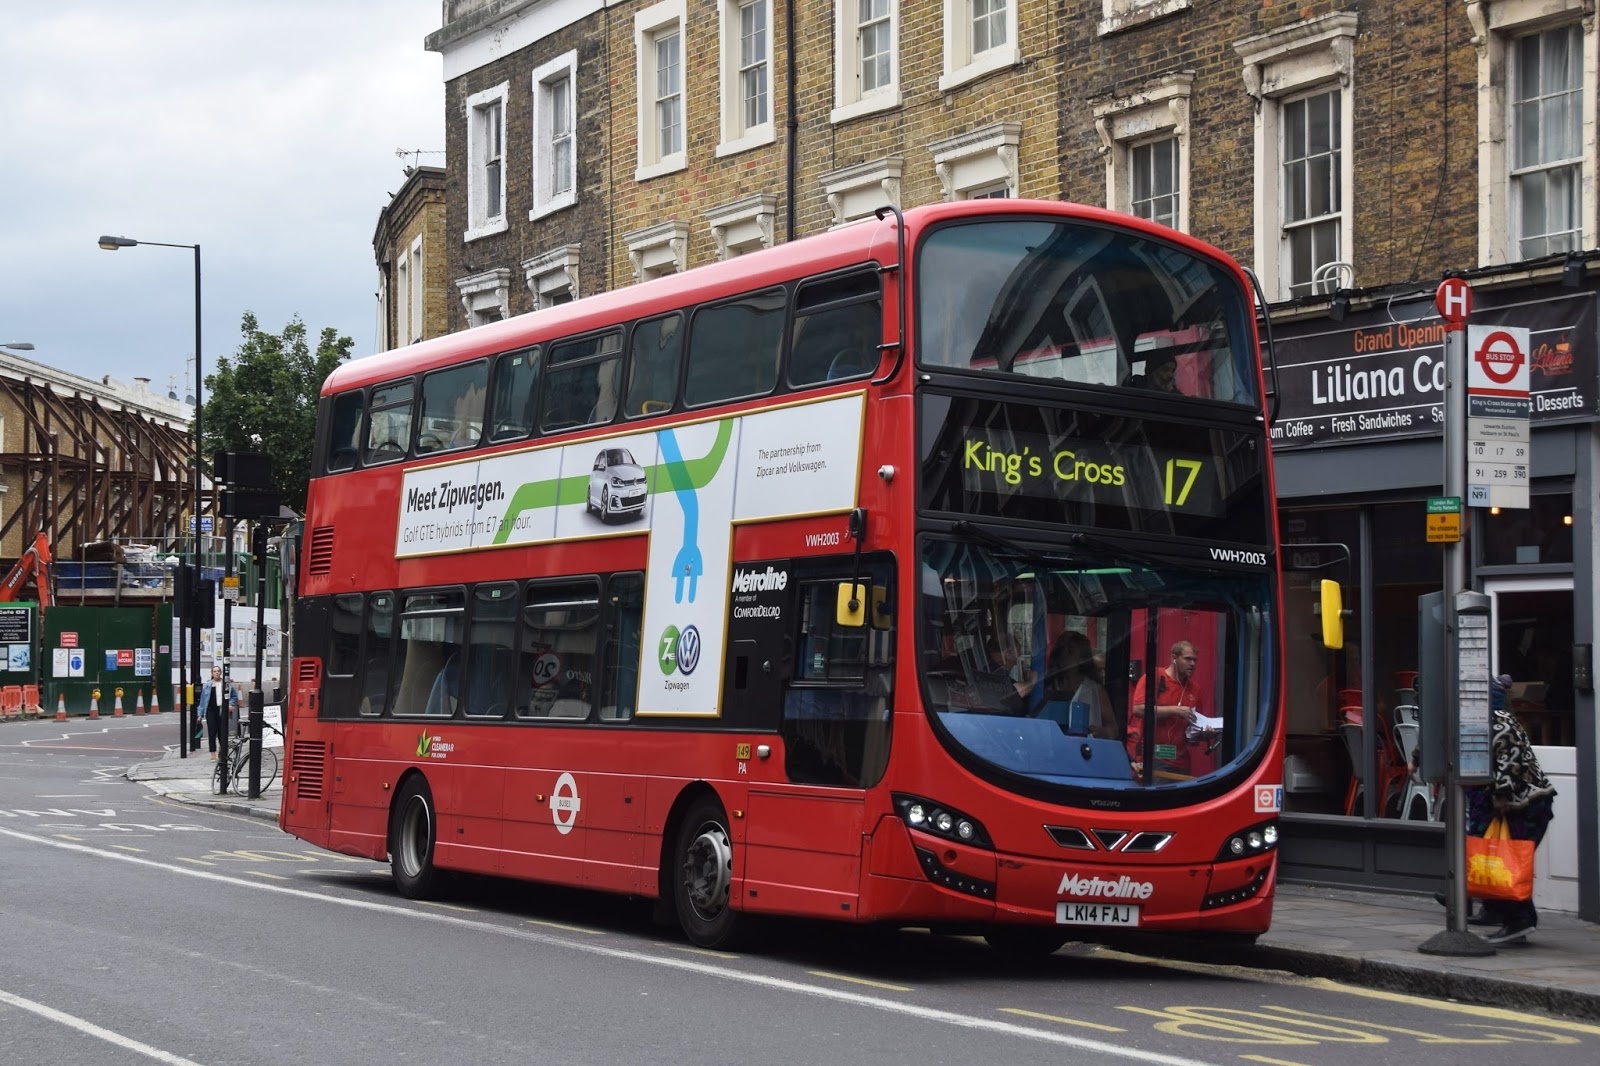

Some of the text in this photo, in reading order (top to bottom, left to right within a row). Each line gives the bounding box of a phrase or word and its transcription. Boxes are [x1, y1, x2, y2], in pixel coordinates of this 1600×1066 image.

[1445, 284, 1467, 317] H
[1354, 321, 1445, 353] Grand Openin
[1485, 353, 1515, 361] BUS STOP
[1530, 343, 1574, 371] Liliana
[1312, 354, 1445, 405] Liliana Co
[1471, 399, 1487, 407] King's
[1500, 400, 1517, 408] Station
[1270, 427, 1284, 439] um
[1285, 421, 1314, 438] Coffee
[1331, 417, 1357, 433] Fresh
[1358, 411, 1412, 431] Sandwiches
[1431, 406, 1444, 423] Sa
[1536, 391, 1584, 412] Desserts
[758, 442, 821, 461] The partnership from
[1474, 446, 1524, 457] 10 17 59
[756, 459, 827, 479] Zipcar and Volkswagen.
[963, 439, 1126, 486] King's Cross
[1164, 458, 1203, 506] 17
[1475, 468, 1526, 479] 91 259 390
[406, 479, 505, 514] Meet Zipwagen.
[1472, 490, 1487, 500] N91
[403, 512, 532, 543] Golf GTE hybrids from £7 an hour.
[805, 532, 840, 547] VWH2003
[1209, 548, 1267, 566] VWH2003
[731, 565, 788, 593] Metroline
[738, 594, 753, 602] member
[664, 680, 690, 692] Zipwagen
[737, 745, 750, 758] 149
[738, 761, 747, 775] PA
[559, 799, 571, 808] BUSES
[1089, 799, 1121, 808] VOLVO
[1056, 872, 1154, 900] Metroline
[1065, 904, 1131, 923] LK14 FAJ
